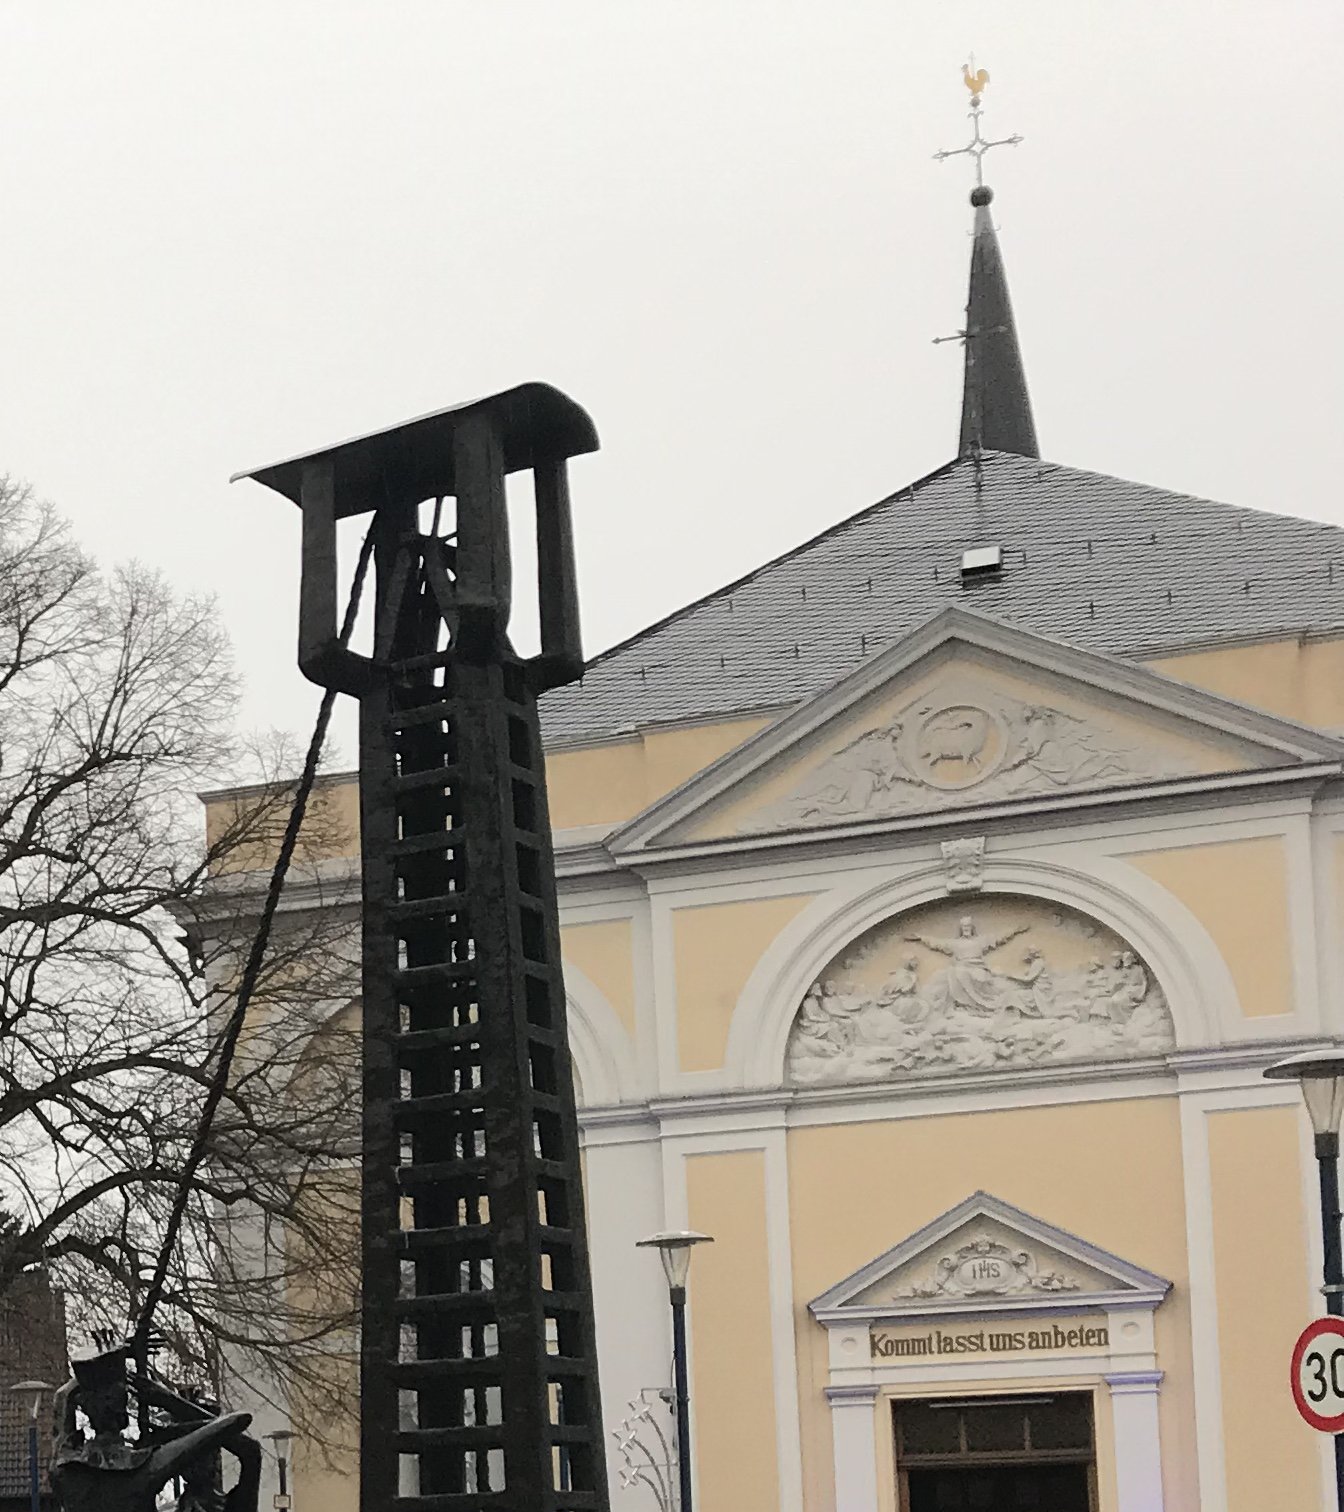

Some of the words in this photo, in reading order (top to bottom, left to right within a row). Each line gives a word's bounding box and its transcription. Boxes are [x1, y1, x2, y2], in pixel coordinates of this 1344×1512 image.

[869, 1331, 934, 1357] Kommt
[936, 1330, 987, 1354] lasst
[988, 1331, 1026, 1352] uns
[1028, 1325, 1111, 1350] anbeten
[1306, 1348, 1344, 1402] 30
